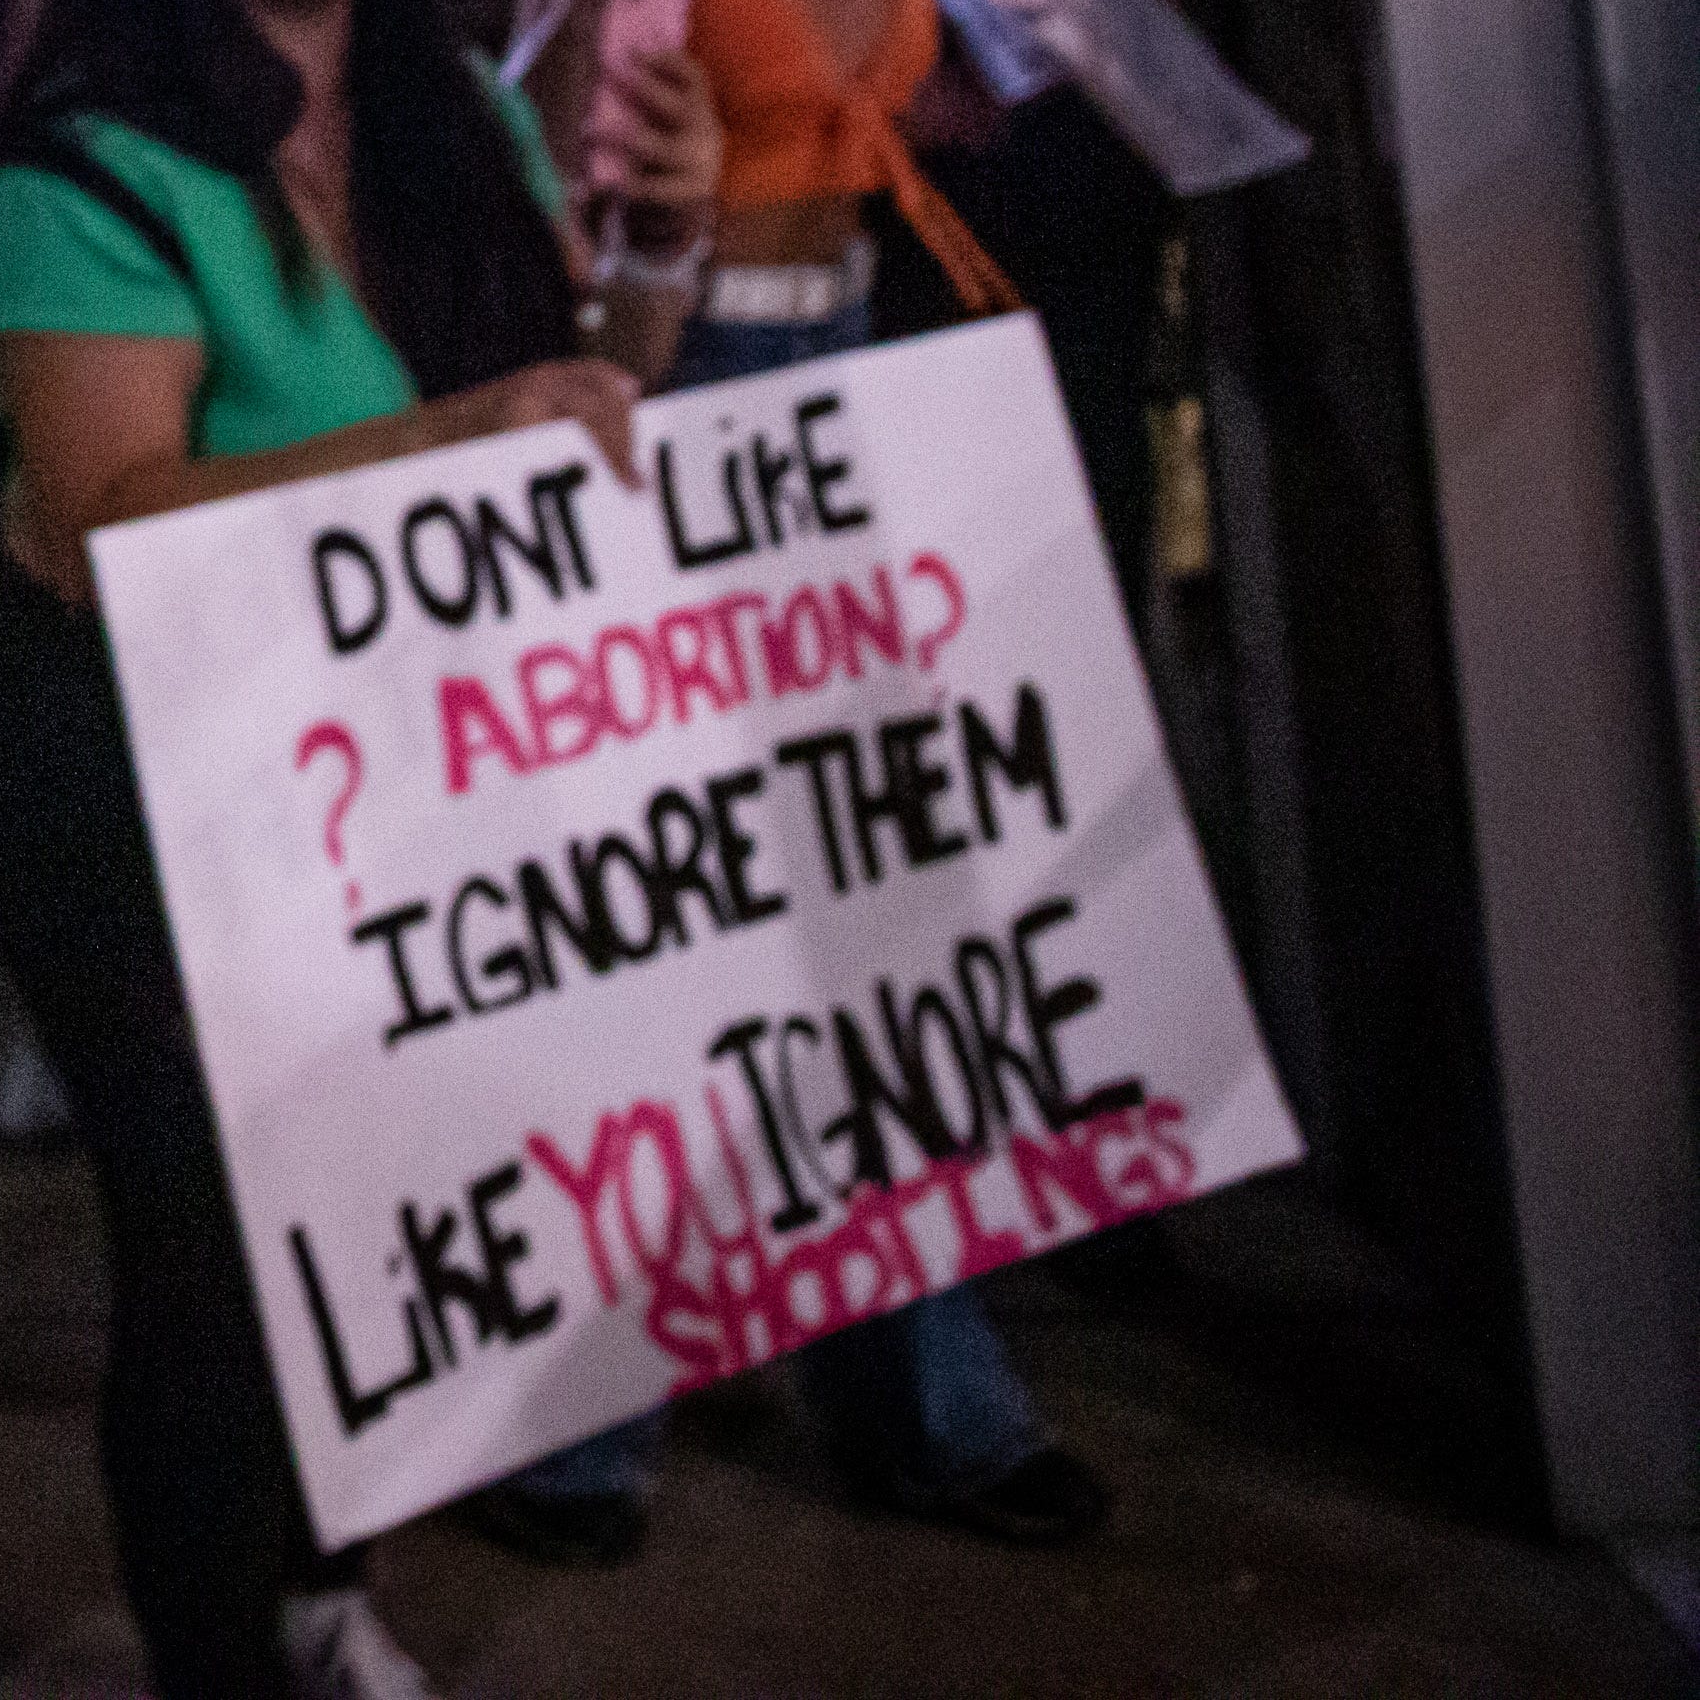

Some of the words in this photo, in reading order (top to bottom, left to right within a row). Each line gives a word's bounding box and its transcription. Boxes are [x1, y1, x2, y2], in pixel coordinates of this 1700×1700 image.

[310, 460, 597, 657] DONT
[352, 764, 790, 1050] IGNORE
[775, 679, 1070, 900] THEM
[522, 1082, 770, 1310] YOU
[707, 898, 1148, 1236] IGNORE
[642, 1098, 1198, 1400] SHOOTINGS
